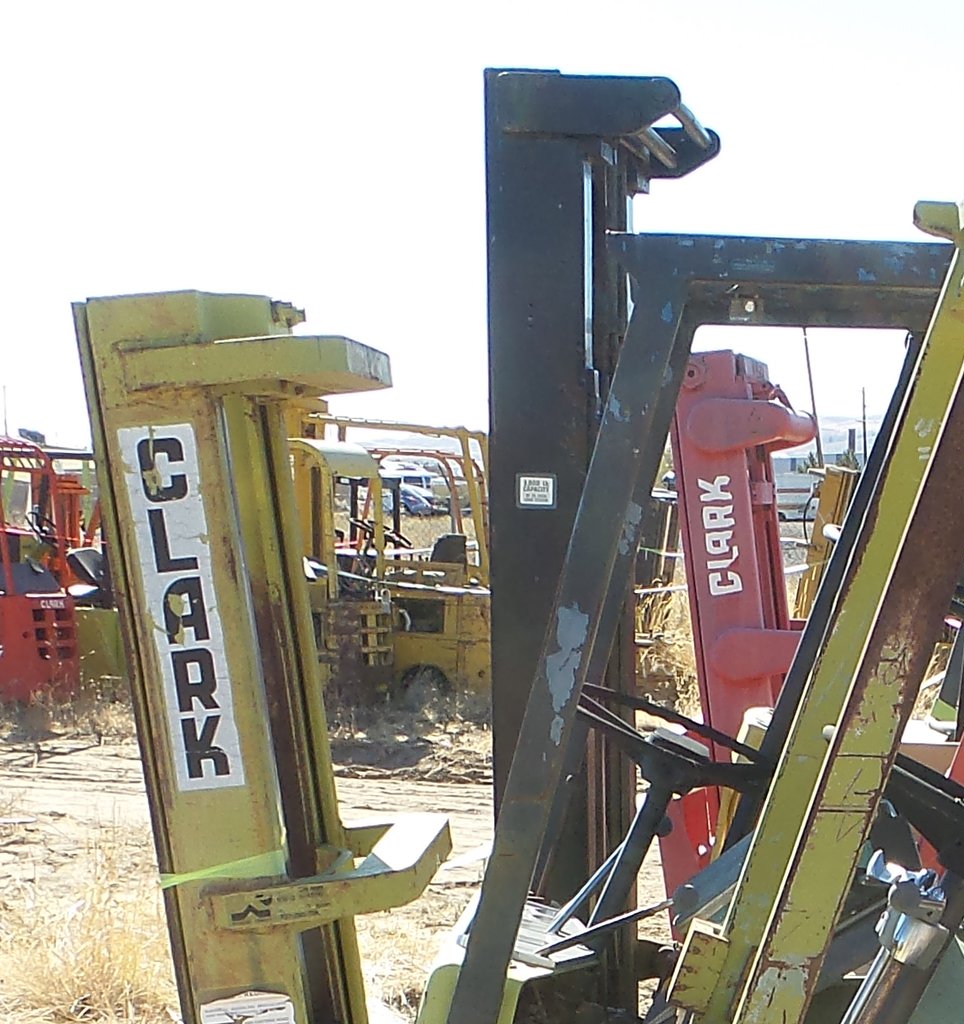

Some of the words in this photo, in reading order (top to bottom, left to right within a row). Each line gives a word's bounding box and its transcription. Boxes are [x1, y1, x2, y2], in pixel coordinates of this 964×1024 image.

[697, 475, 743, 596] CLARK
[40, 600, 65, 609] CLARK
[136, 437, 231, 779] CLARK
